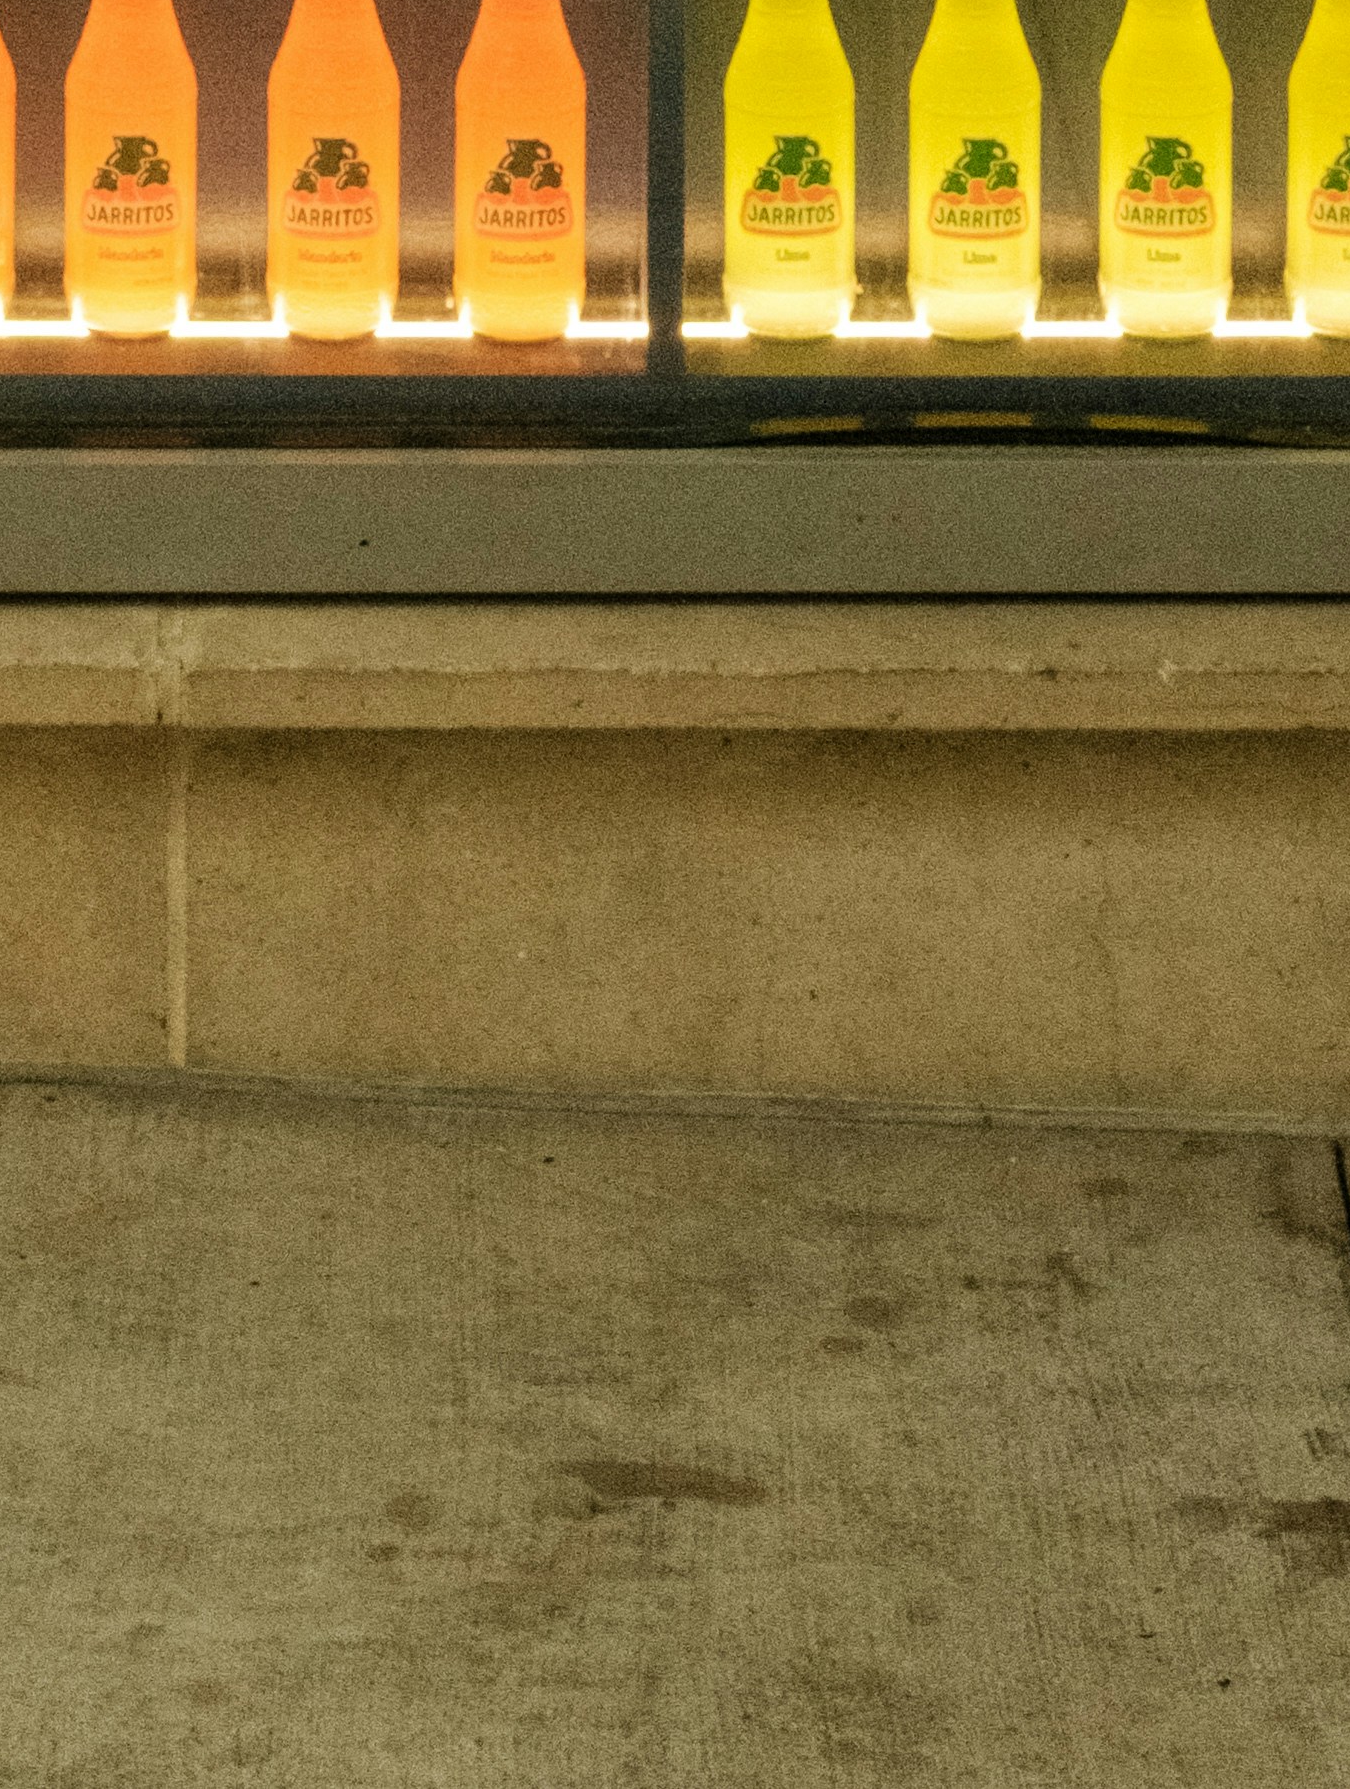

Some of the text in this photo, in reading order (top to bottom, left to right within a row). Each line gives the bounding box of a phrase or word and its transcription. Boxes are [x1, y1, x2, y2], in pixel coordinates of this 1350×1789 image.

[87, 204, 173, 224] JARRITOS
[288, 206, 373, 227] JARRITOS
[479, 206, 566, 228] JARRITOS
[748, 204, 835, 225] JARRITOS
[935, 206, 1021, 227] JARRITOS
[1120, 205, 1207, 225] JARRITOS
